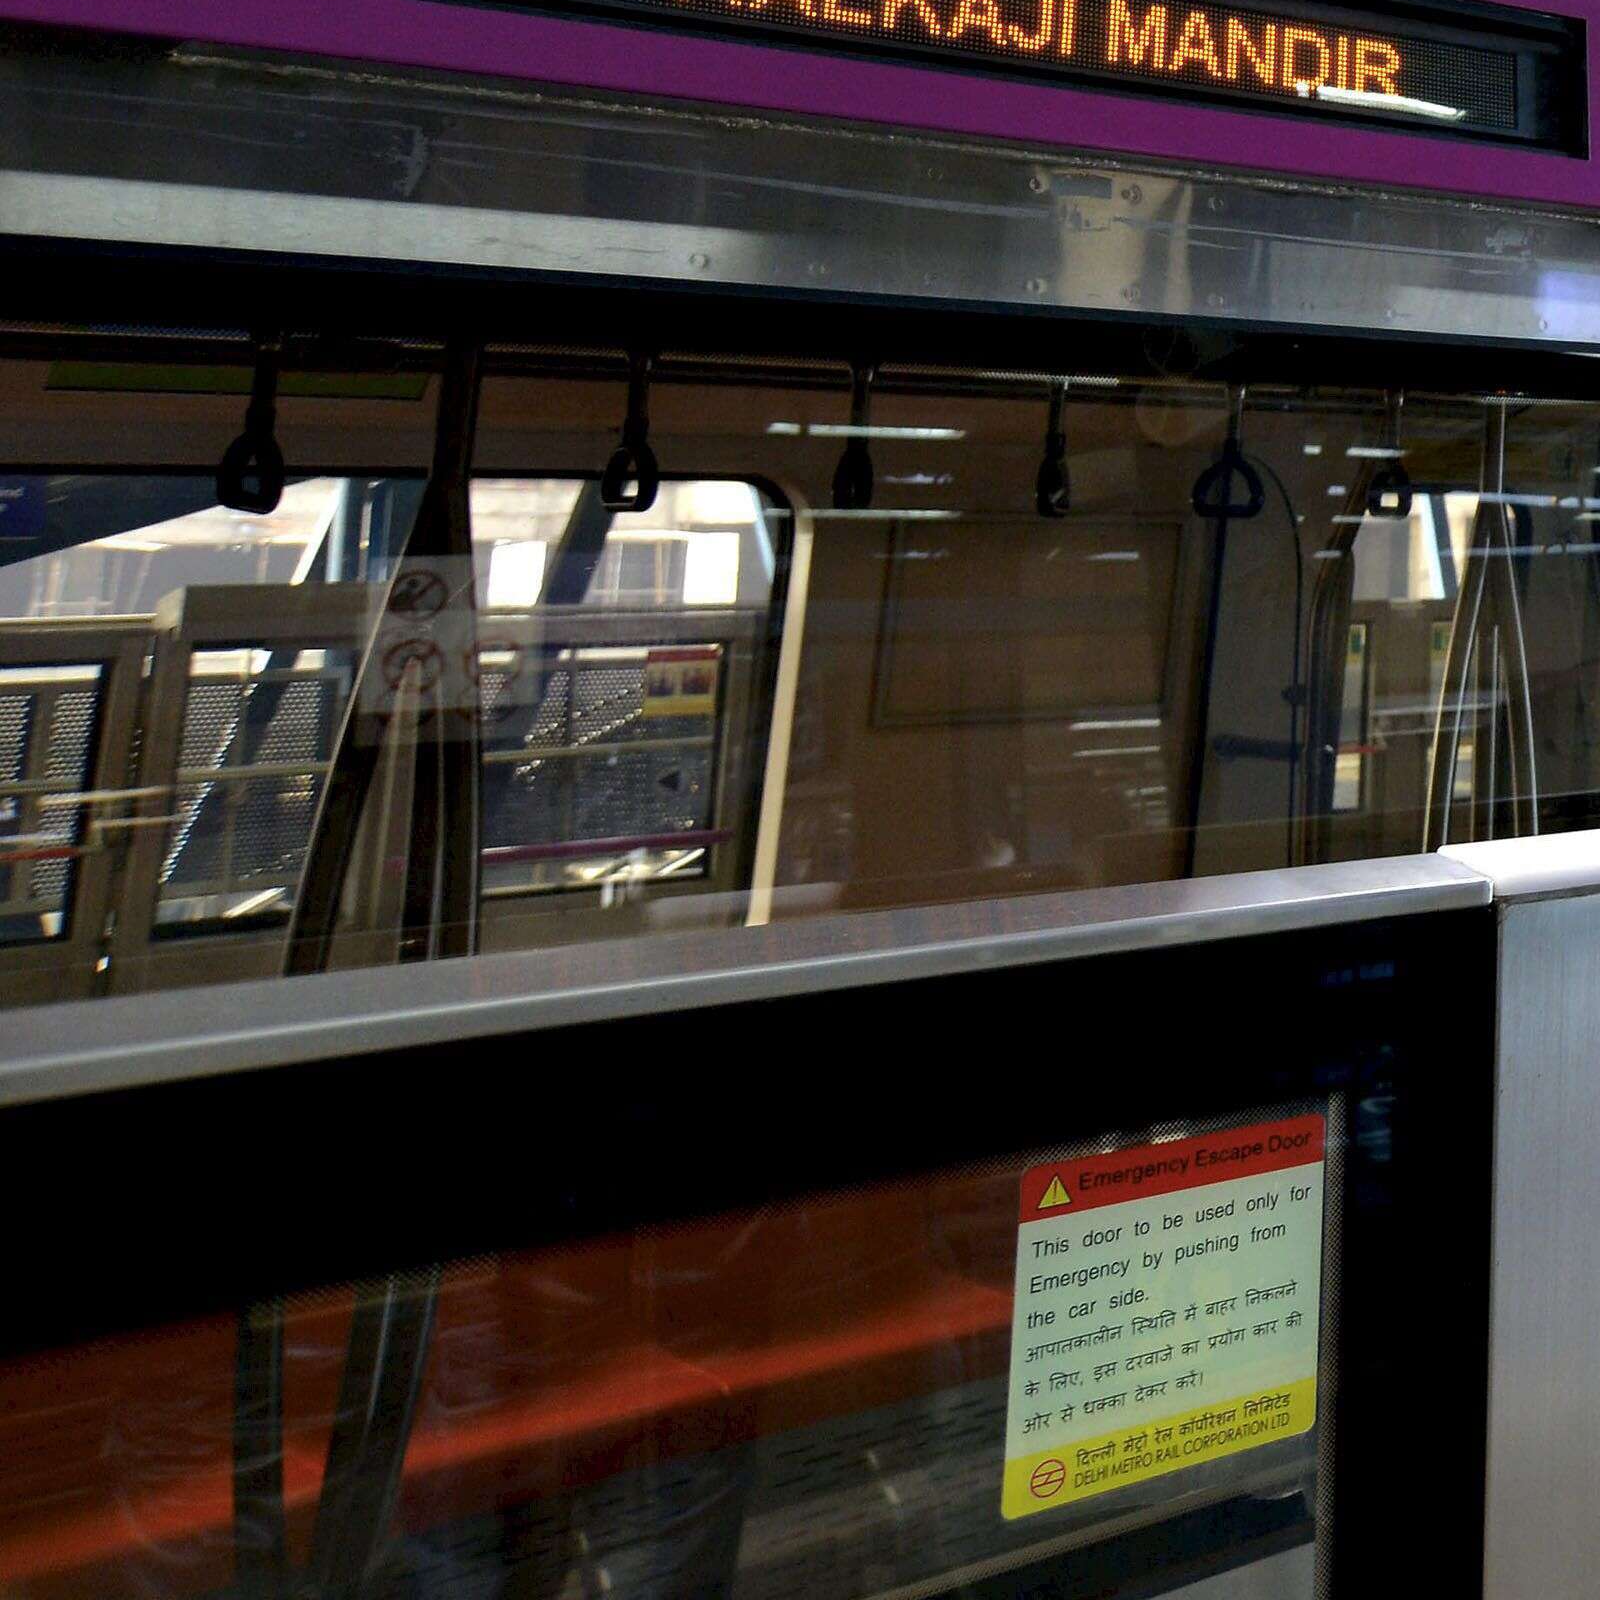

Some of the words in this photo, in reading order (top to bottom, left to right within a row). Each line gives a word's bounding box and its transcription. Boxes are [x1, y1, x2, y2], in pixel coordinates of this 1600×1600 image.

[1078, 1156, 1188, 1190] Emergency
[1195, 1141, 1263, 1167] Escape
[1268, 1131, 1312, 1151] Door
[1032, 1237, 1069, 1258] This
[1082, 1226, 1122, 1247] door
[1134, 1220, 1150, 1236] to
[1163, 1213, 1183, 1230] be
[1196, 1201, 1235, 1223] used
[1246, 1192, 1279, 1212] only
[1290, 1184, 1312, 1202] for
[1030, 1257, 1130, 1293] Emergency
[1142, 1250, 1163, 1270] by
[1175, 1233, 1239, 1264] pushing
[1250, 1223, 1286, 1243] from
[1027, 1310, 1055, 1329] the
[1068, 1299, 1097, 1319] car
[1109, 1287, 1149, 1309] side.
[1253, 1319, 1280, 1337] कार
[1073, 1468, 1108, 1489] DELHI
[1110, 1453, 1153, 1479] METRO
[1155, 1444, 1180, 1464] RAIL
[1183, 1420, 1269, 1459] CORPORATION
[1269, 1412, 1291, 1430] LTD
